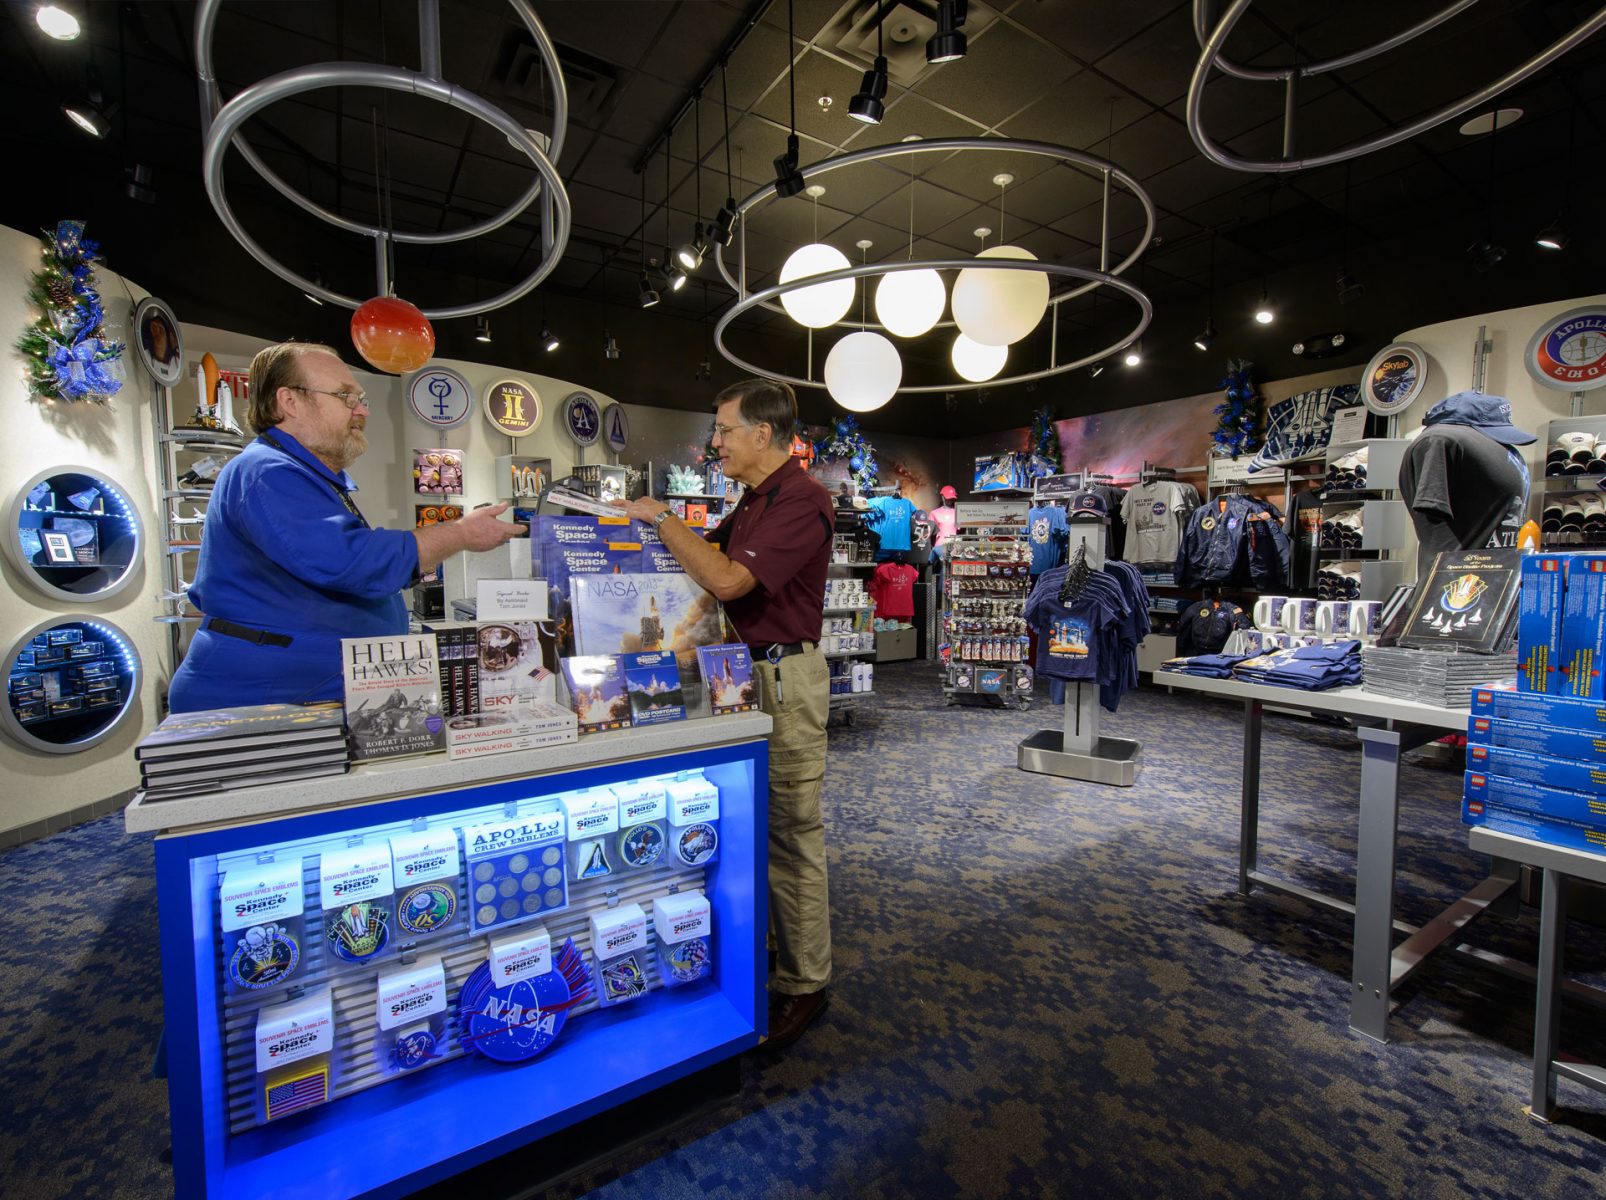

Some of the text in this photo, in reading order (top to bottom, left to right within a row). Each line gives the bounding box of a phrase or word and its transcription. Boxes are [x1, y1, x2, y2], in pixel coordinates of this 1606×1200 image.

[1383, 361, 1408, 370] Skylab
[502, 387, 523, 395] NASA
[499, 418, 529, 427] GEMINI
[555, 531, 597, 540] Space
[563, 551, 605, 559] Kennedy
[566, 557, 608, 566] Space
[588, 580, 658, 598] NASA 2013
[350, 640, 432, 665] HELL
[351, 660, 432, 680] HAWKS!
[454, 665, 464, 716] HELL HAWK
[469, 664, 479, 714] HELL HAWK
[484, 695, 516, 706] SKY
[1543, 697, 1580, 706] Transbordador
[159, 709, 336, 731] PLANETOLOGY
[473, 728, 512, 739] WALKING
[1540, 726, 1577, 736] Transbordador
[366, 738, 398, 748] ROBERT
[408, 734, 431, 742] DORR
[363, 744, 400, 755] THOMAS
[410, 741, 434, 750] JONES
[455, 747, 472, 755] SKY
[473, 742, 513, 753] WALKING
[1538, 756, 1575, 766] Transbordador
[1536, 785, 1573, 795] Transbordador
[627, 804, 657, 816] Space
[682, 804, 711, 816] Space
[577, 816, 609, 828] Space
[685, 825, 705, 837] APOLLO
[475, 830, 559, 853] CREW EMBLEMS
[404, 859, 446, 874] Space
[333, 878, 378, 892] Space
[247, 893, 282, 904] Kennedy
[235, 897, 287, 914] Space
[674, 920, 702, 932] Space
[606, 933, 638, 947] Space
[504, 957, 540, 972] Space
[391, 995, 432, 1013] Space
[481, 995, 556, 1036] NASA
[259, 1019, 329, 1044] SOUVENIR SPACE EMBLEMS
[269, 1035, 317, 1053] Space
[280, 1032, 313, 1044] Kennedy
[285, 1043, 310, 1052] Center
